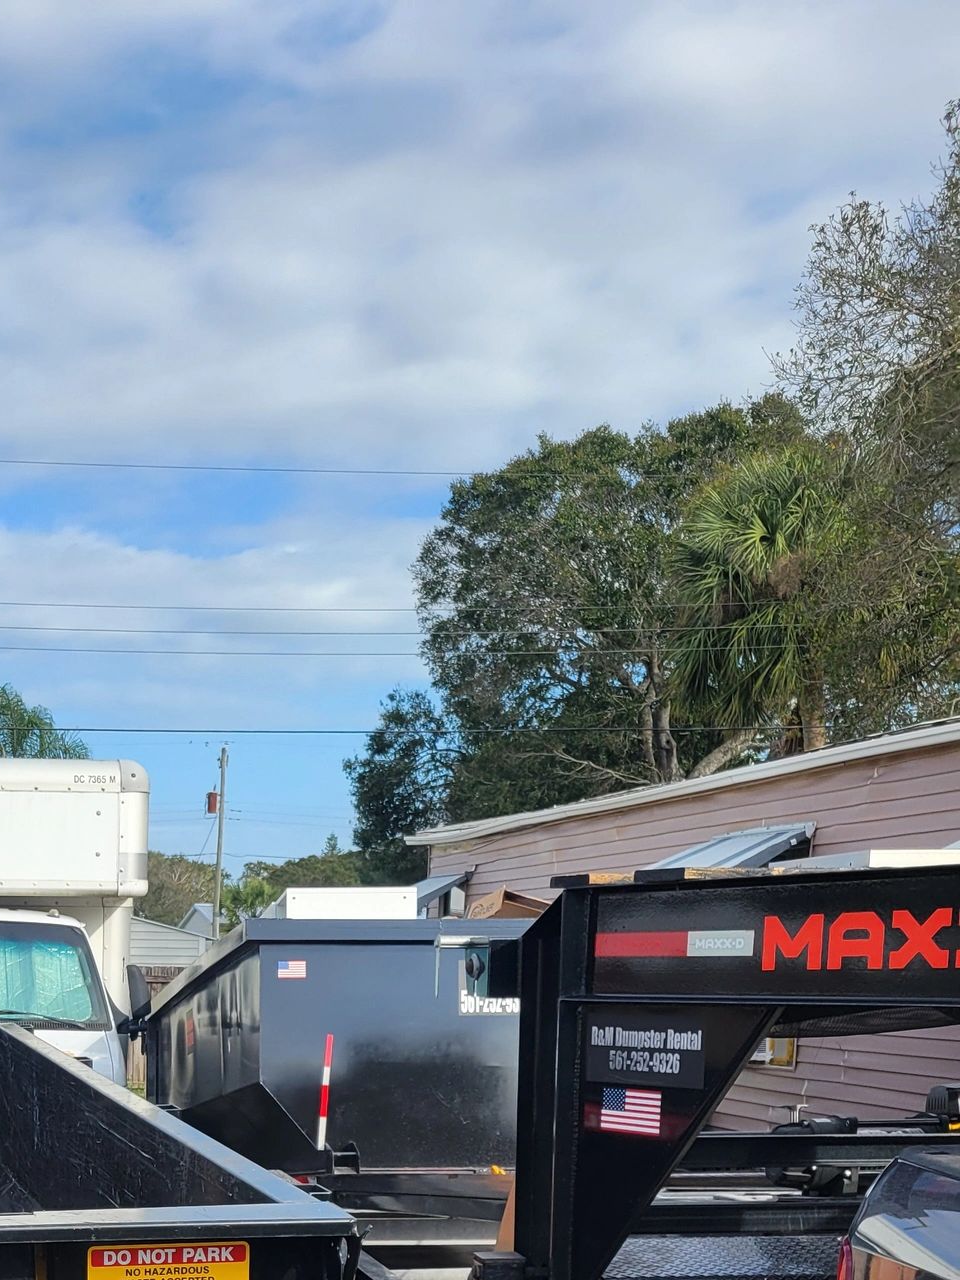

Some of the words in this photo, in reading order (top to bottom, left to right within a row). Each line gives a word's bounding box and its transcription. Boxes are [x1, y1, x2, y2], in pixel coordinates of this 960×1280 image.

[73, 774, 85, 784] DC
[87, 774, 107, 784] 7365
[109, 775, 116, 784] M
[761, 907, 960, 971] MAX
[591, 1026, 614, 1047] R&M
[615, 1027, 666, 1050] Dumpster
[666, 1029, 702, 1051] Rental
[609, 1050, 681, 1074] 561-252-9326
[103, 1249, 132, 1266] DO
[137, 1248, 177, 1265] NOT
[182, 1246, 234, 1263] PARK
[125, 1268, 141, 1277] NO
[144, 1266, 210, 1276] HAZARDOUS
